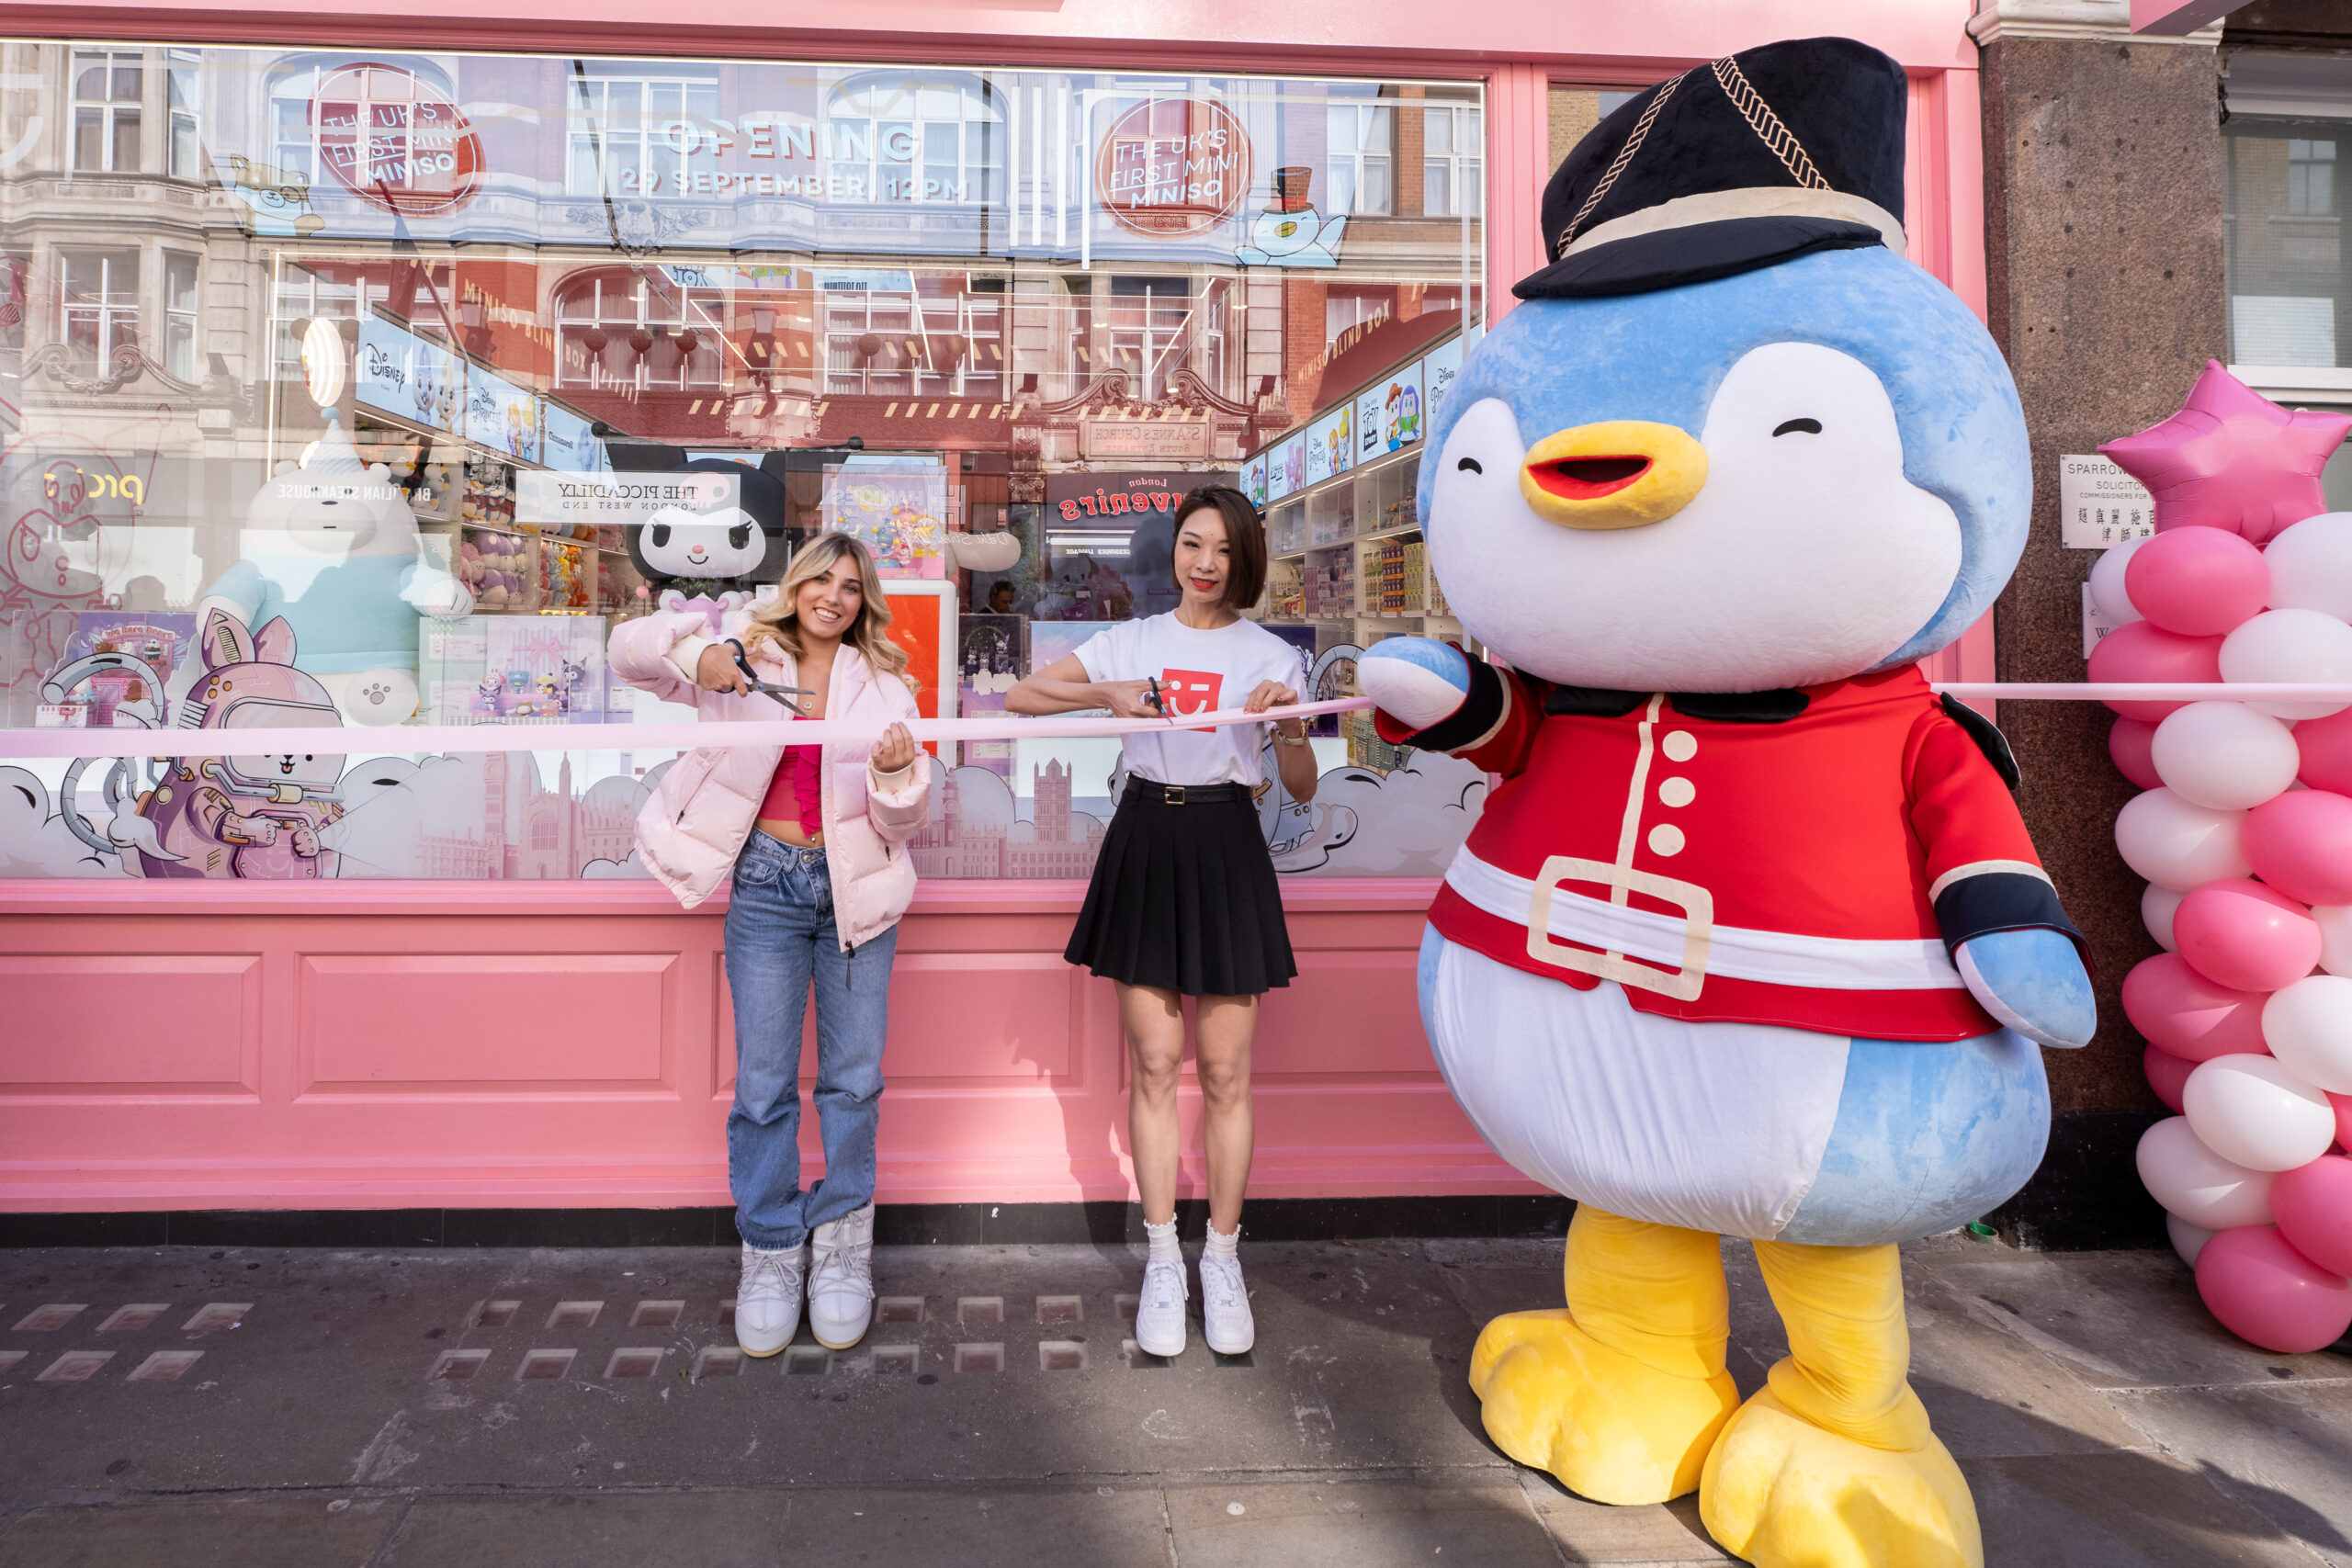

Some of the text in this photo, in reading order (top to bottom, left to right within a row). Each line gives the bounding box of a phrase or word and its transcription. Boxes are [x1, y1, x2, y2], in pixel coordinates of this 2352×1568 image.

[332, 135, 397, 164] FIRST
[661, 118, 922, 163] OPENING
[1116, 129, 1228, 163] THE UK'S
[365, 152, 456, 186] MINISO
[620, 168, 662, 192] 29
[887, 177, 970, 201] 12PM
[1109, 152, 1239, 188] FIRST MINI
[1130, 179, 1222, 209] MINISO
[464, 278, 586, 372] MINISO BLIN BOX
[1297, 298, 1390, 386] MINISO BLIND BOX
[1363, 407, 1379, 435] TOY
